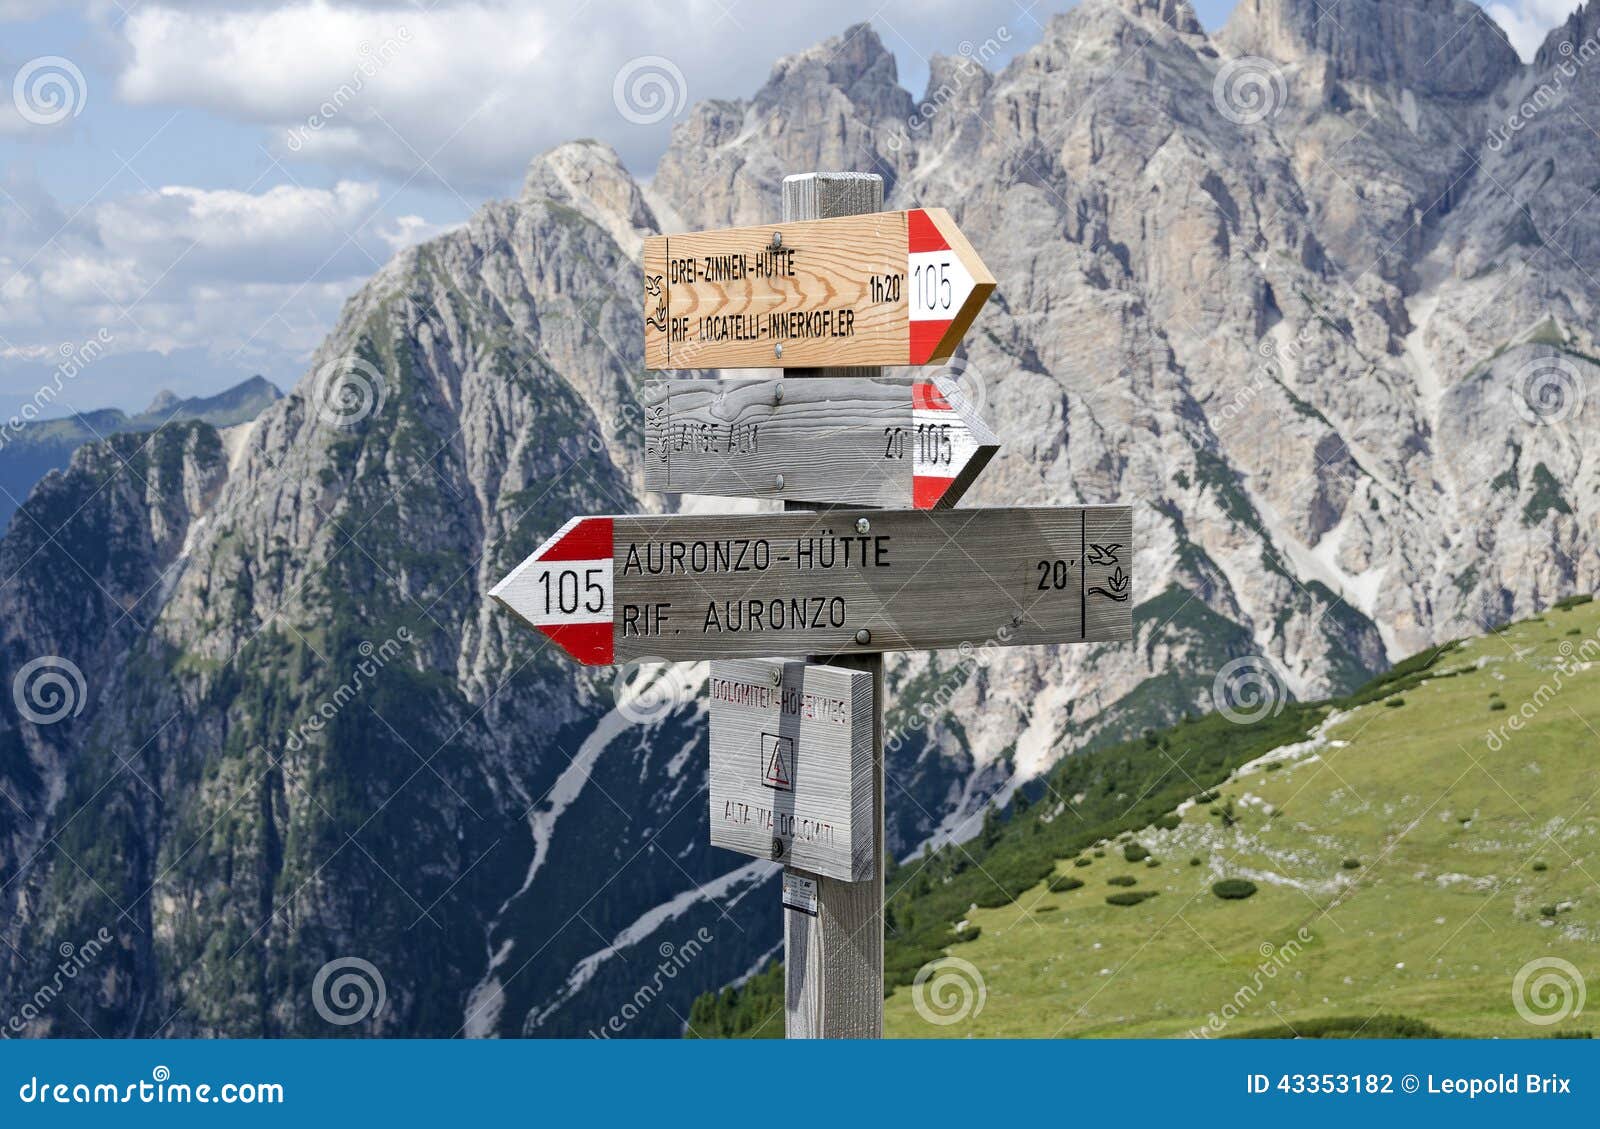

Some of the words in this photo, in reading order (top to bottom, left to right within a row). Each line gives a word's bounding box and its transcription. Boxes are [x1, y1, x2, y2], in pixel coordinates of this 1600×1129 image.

[671, 246, 796, 284] DREI-ZINNEN-HÜTTE
[870, 274, 904, 303] 1h20'
[914, 263, 951, 310] 105
[671, 317, 693, 342] RIF.
[700, 309, 855, 341] LOCATELLI-INNERKOFLER
[917, 423, 952, 464] 105
[622, 529, 891, 577] AURONZO-HÜTTE
[538, 569, 605, 615] 105
[1037, 559, 1075, 591] 20'
[622, 602, 682, 638] RIF.
[703, 596, 847, 634] AURONZO
